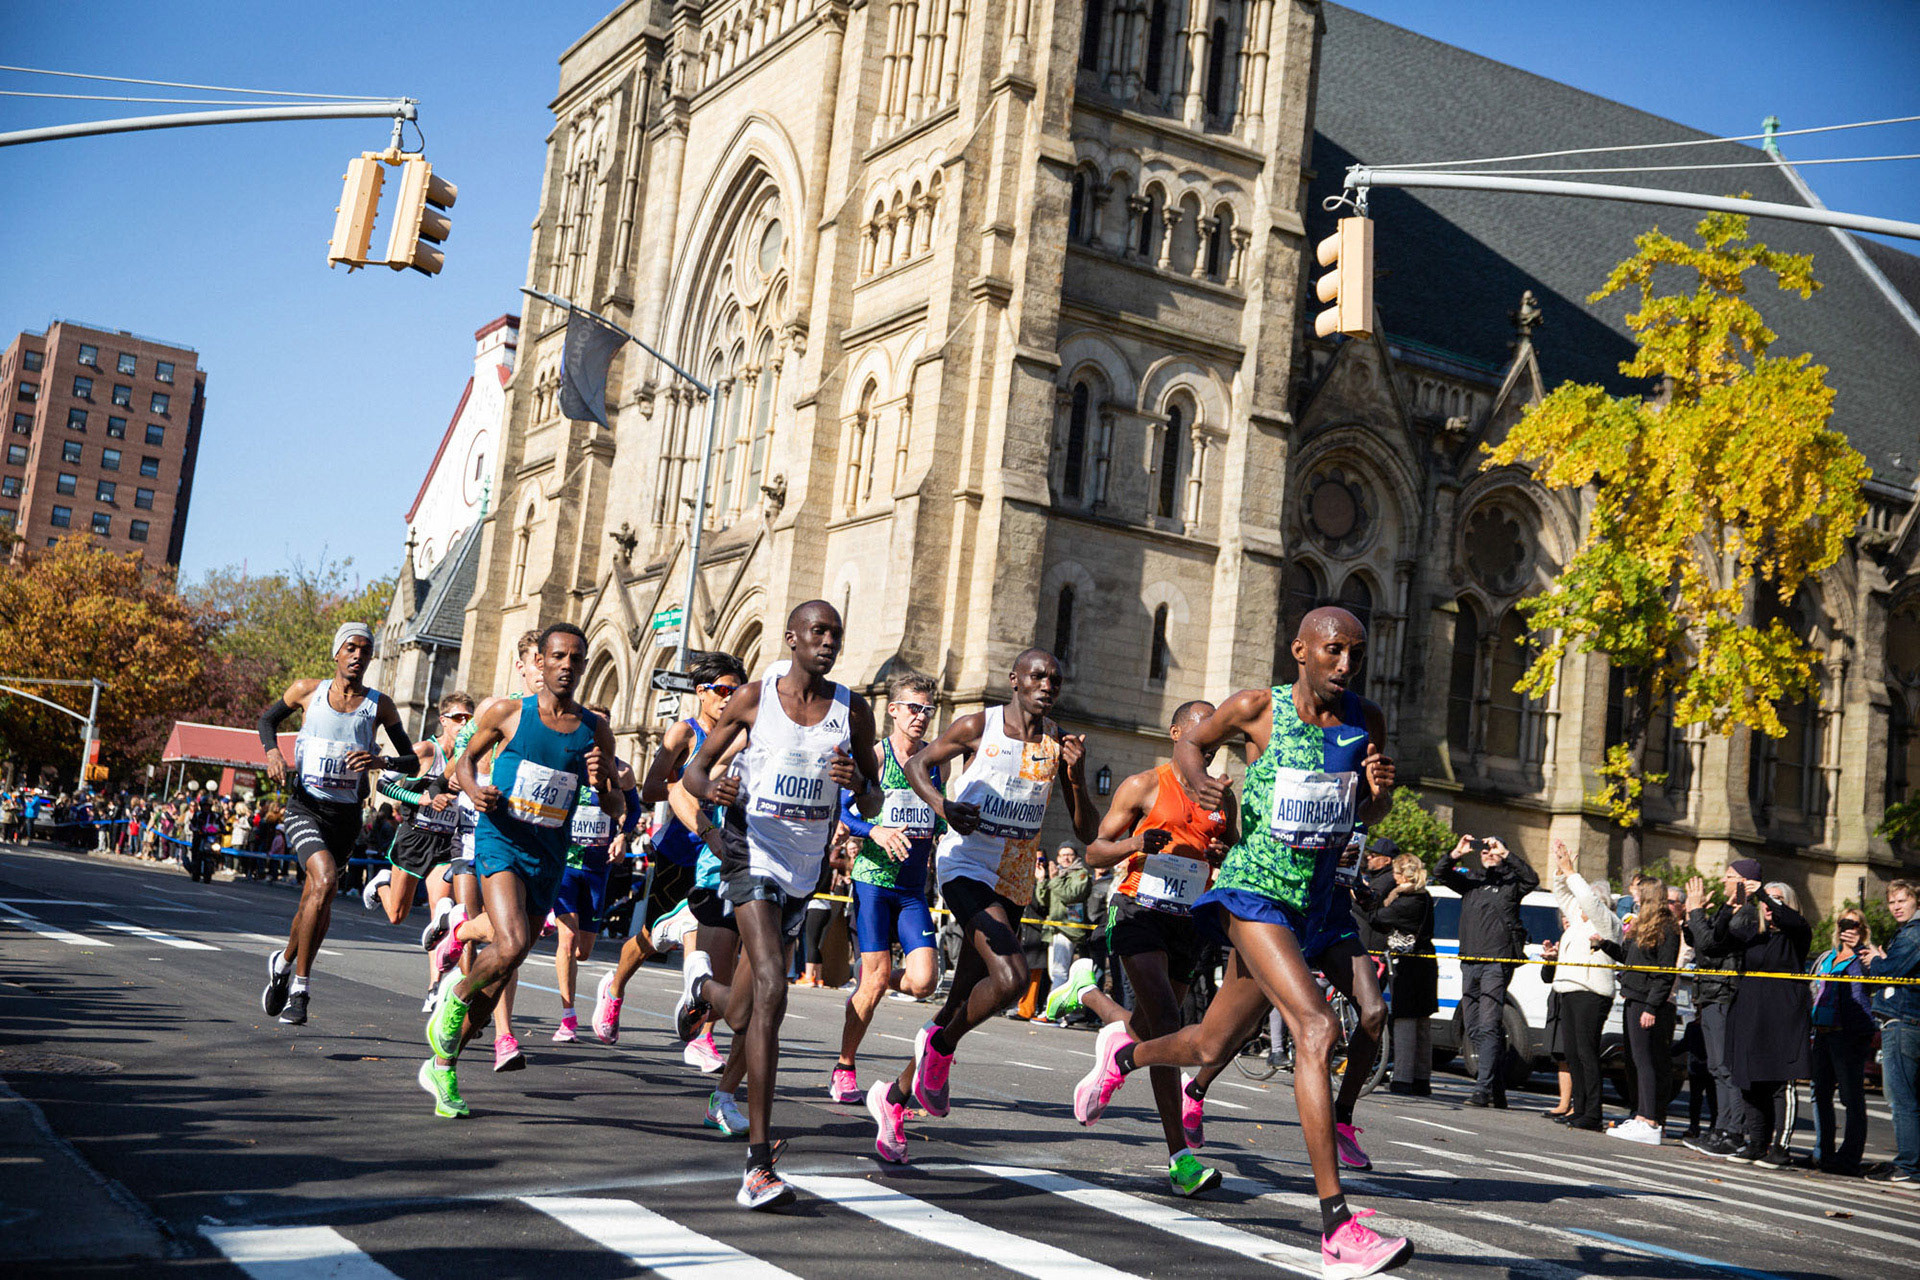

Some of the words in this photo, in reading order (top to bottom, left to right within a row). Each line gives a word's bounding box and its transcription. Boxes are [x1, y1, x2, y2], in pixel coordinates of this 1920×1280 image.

[660, 676, 677, 686] ONE
[319, 756, 347, 775] TOLA
[532, 784, 558, 805] 443
[775, 774, 823, 800] KORIR
[759, 801, 777, 811] 2019
[891, 807, 930, 823] GABIUS
[1277, 798, 1352, 824] ABDIRAHMAN
[1163, 875, 1187, 898] YAE
